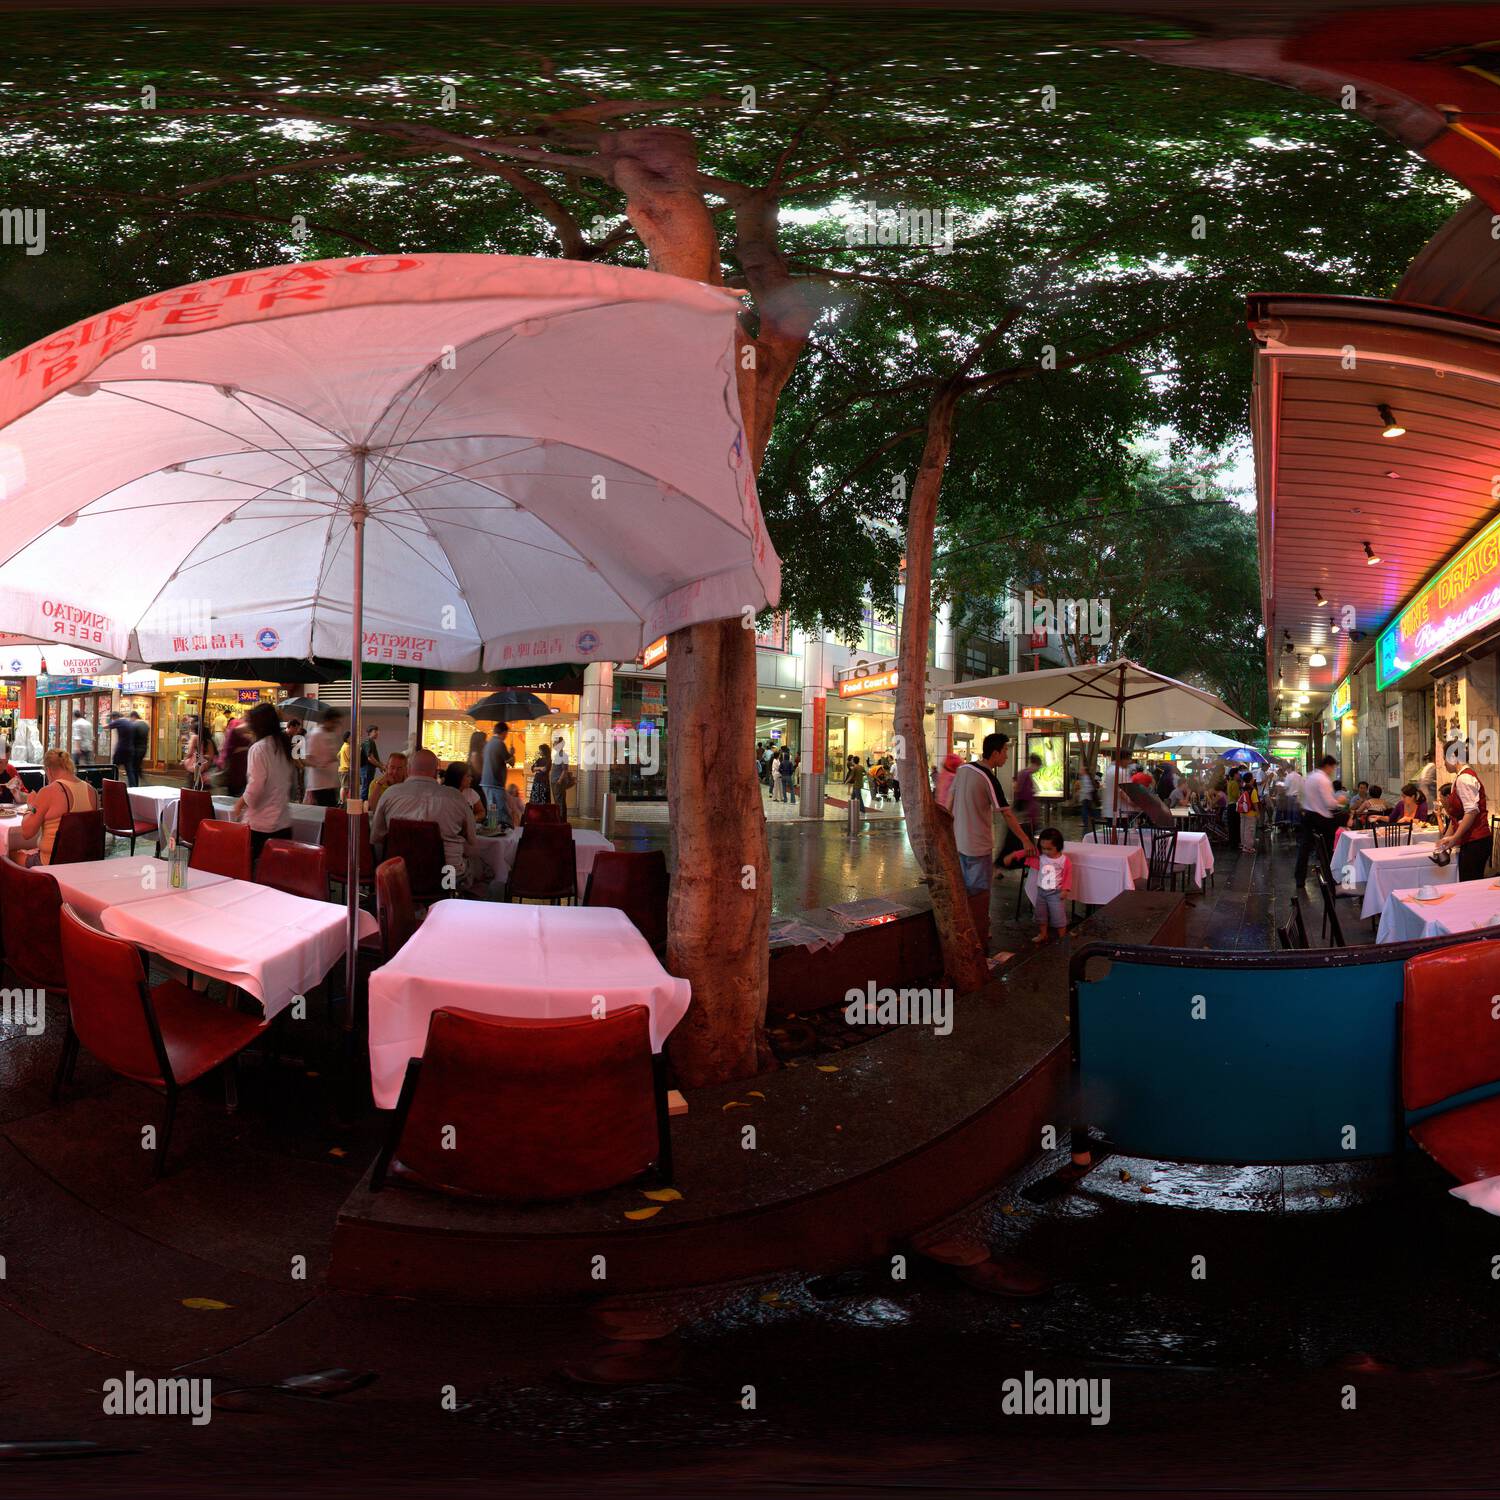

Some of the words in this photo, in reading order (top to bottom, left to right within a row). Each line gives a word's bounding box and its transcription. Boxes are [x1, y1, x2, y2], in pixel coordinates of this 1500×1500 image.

[10, 258, 422, 378] TSINGTAO
[41, 284, 328, 390] BEER
[240, 691, 258, 700] SALE
[864, 676, 888, 689] Court
